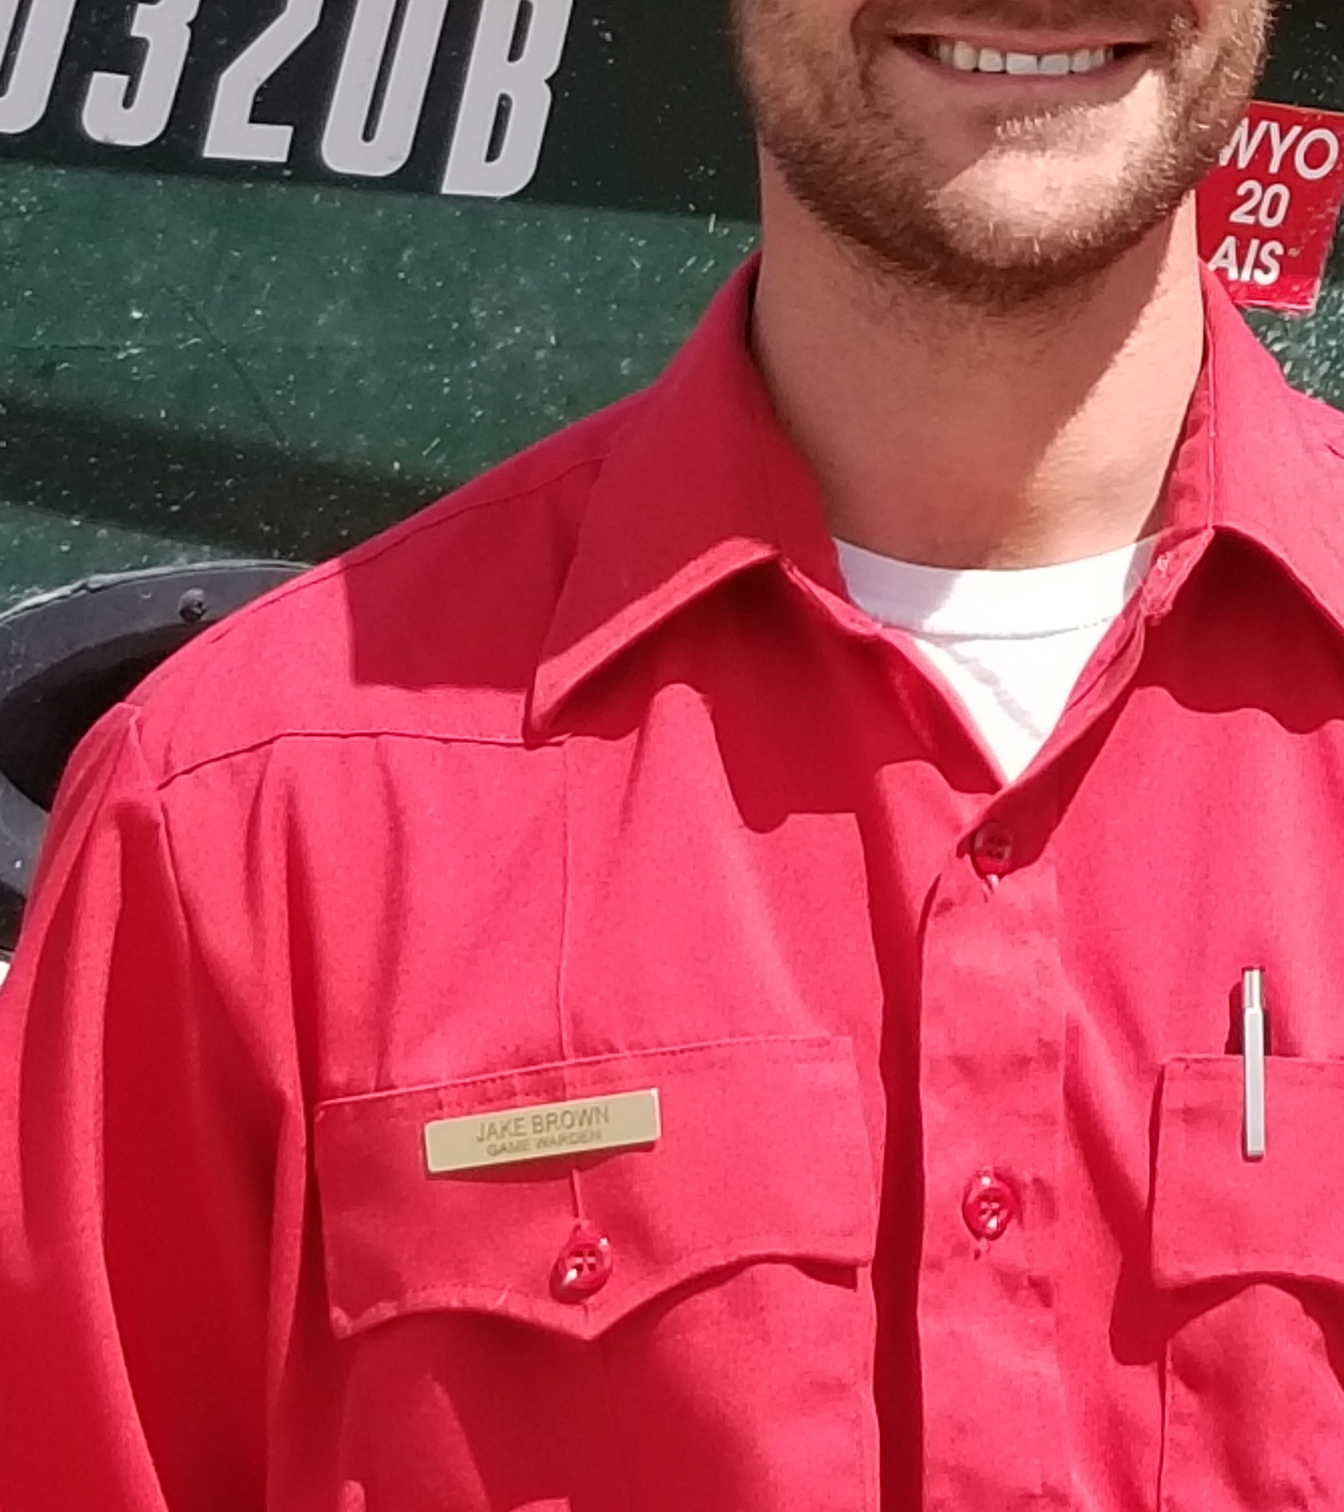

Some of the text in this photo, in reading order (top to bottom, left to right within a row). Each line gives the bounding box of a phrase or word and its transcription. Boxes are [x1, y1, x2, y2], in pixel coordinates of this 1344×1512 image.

[1219, 117, 1339, 180] WYO
[1229, 180, 1290, 228] 20
[1207, 235, 1284, 285] AIS
[476, 1105, 610, 1143] JAKE BROWN
[486, 1131, 604, 1157] GAME WARDEN
